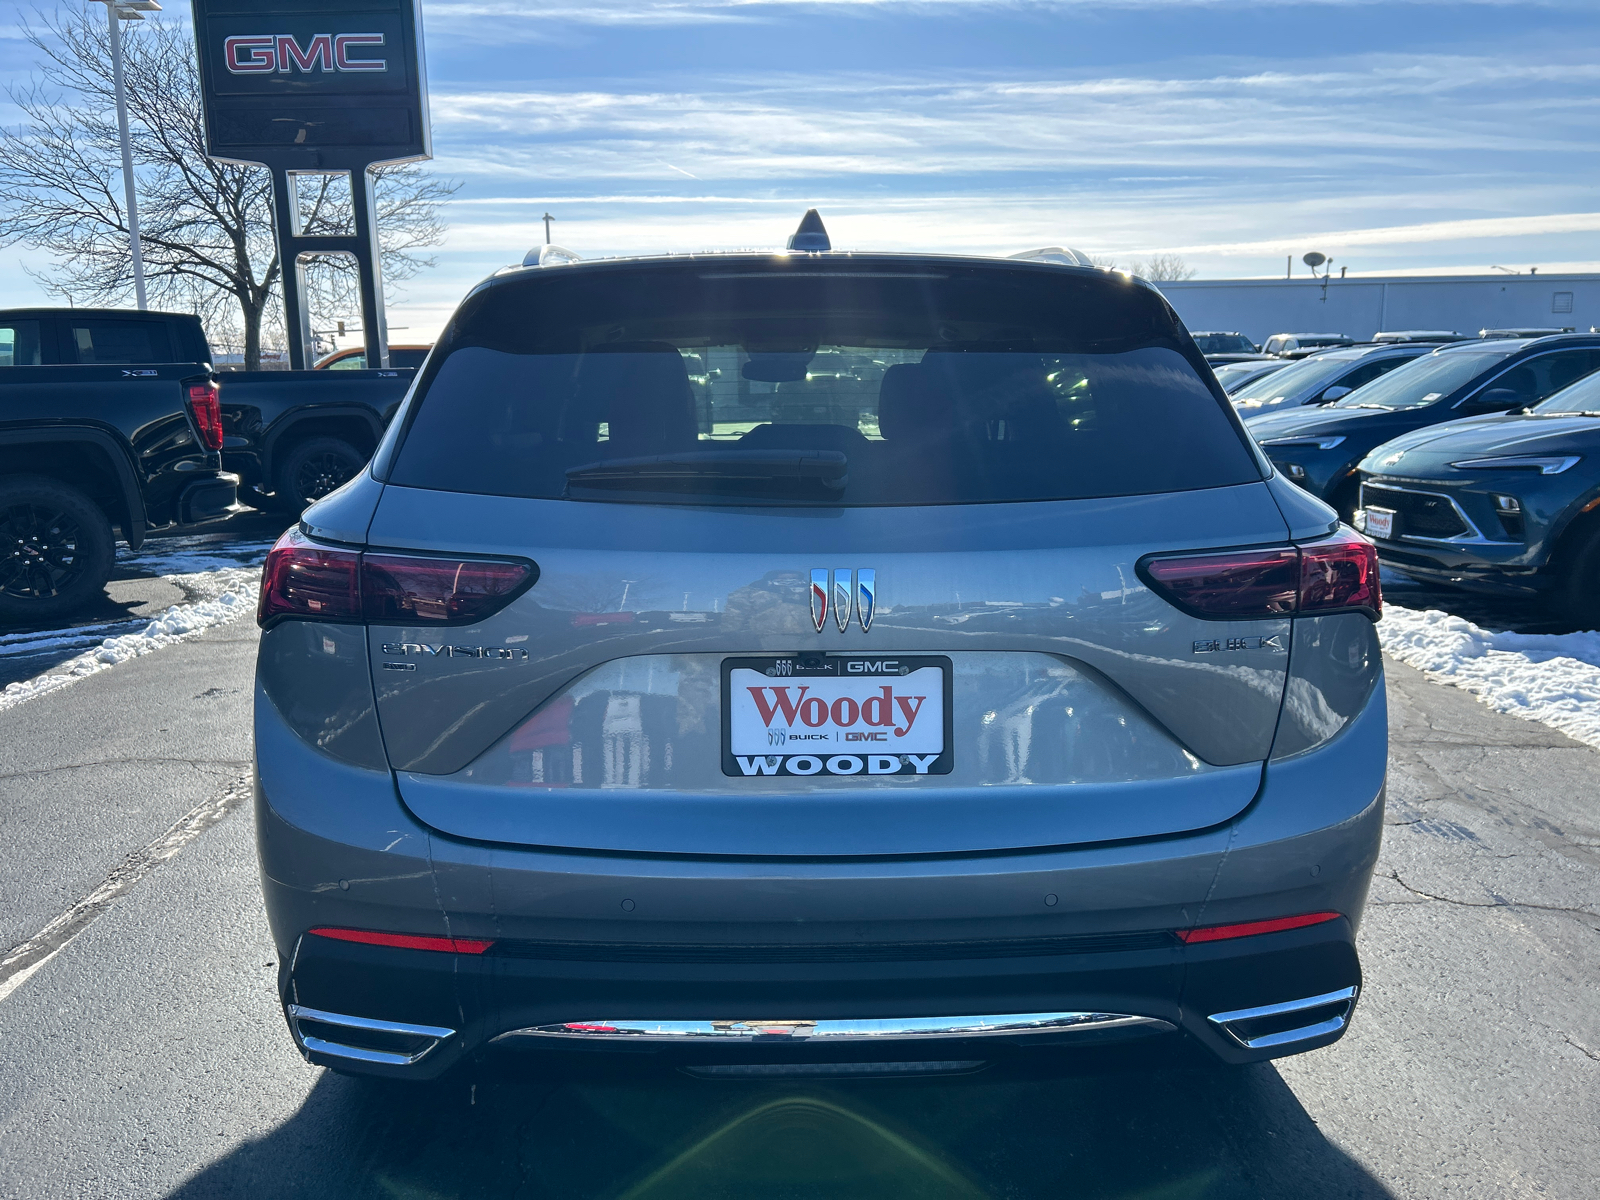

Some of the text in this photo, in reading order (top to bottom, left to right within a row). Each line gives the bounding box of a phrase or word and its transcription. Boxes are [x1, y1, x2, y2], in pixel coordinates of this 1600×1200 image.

[224, 33, 388, 74] GMC
[1369, 514, 1390, 529] Woody
[381, 643, 529, 660] ENVISION
[1192, 635, 1280, 653] BUICK
[847, 661, 899, 672] GMC
[747, 686, 927, 737] Woody
[845, 732, 888, 741] GMC
[735, 755, 940, 775] WOODY
